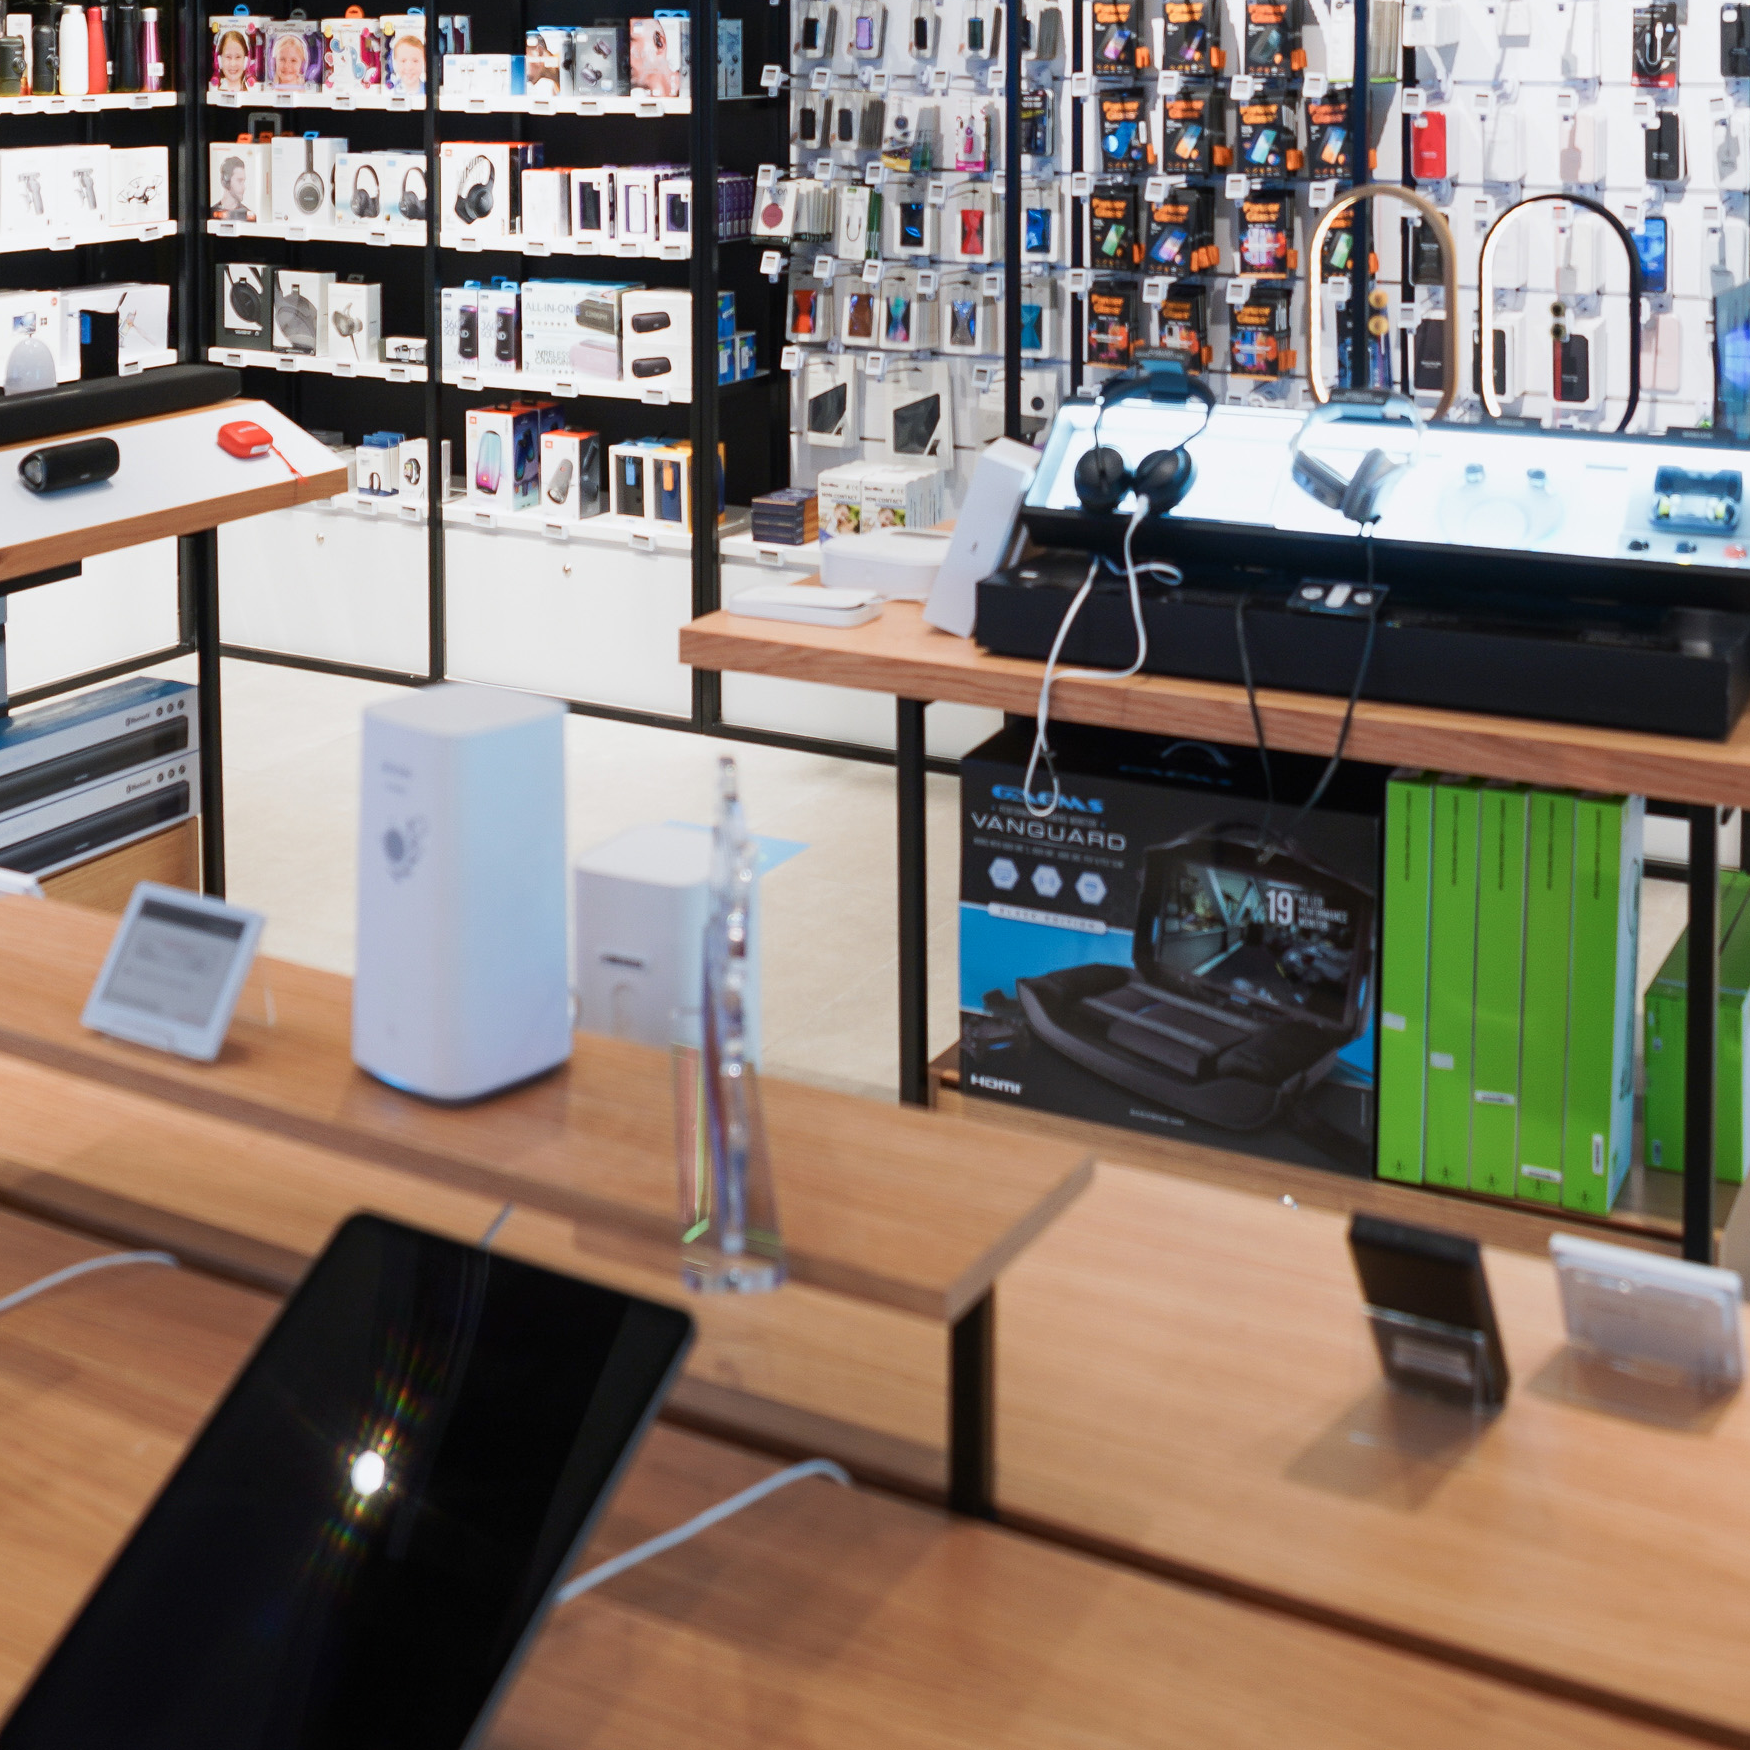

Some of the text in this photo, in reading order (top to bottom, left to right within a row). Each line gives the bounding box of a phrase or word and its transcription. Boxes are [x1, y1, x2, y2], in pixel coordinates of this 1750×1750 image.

[970, 811, 1127, 852] VANGUARD
[1265, 889, 1293, 927] 19
[970, 1072, 1023, 1096] HDMI
